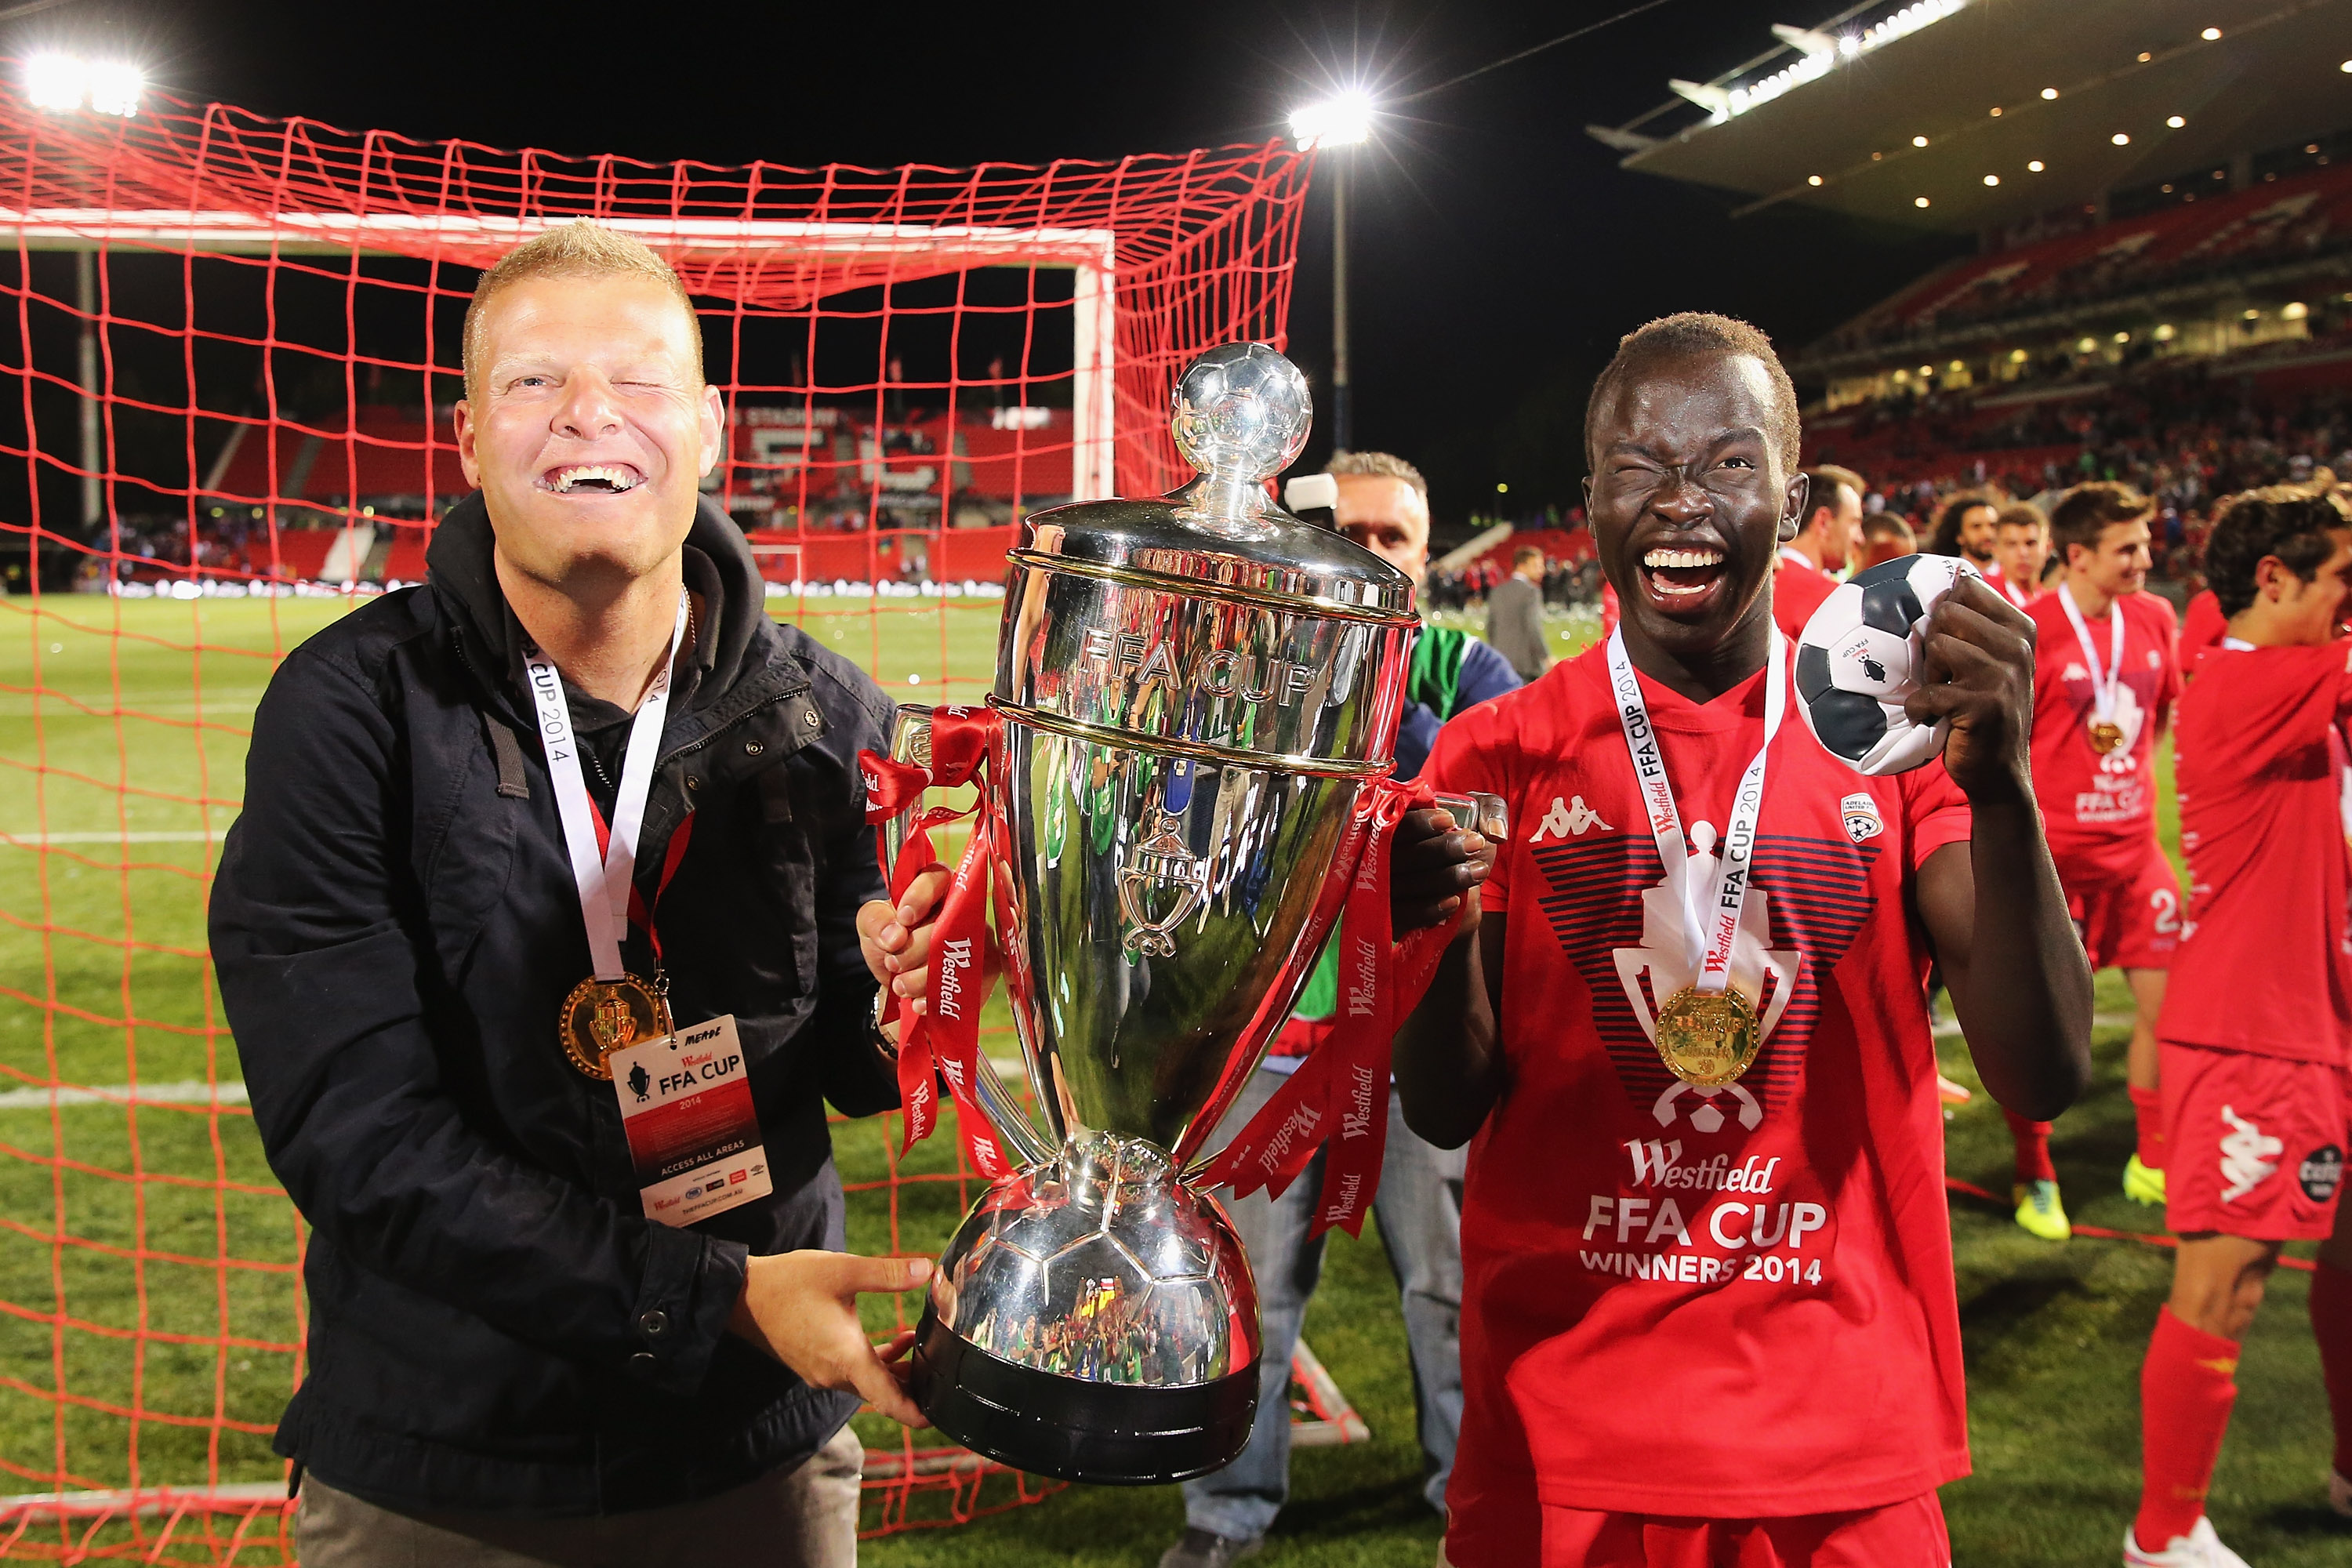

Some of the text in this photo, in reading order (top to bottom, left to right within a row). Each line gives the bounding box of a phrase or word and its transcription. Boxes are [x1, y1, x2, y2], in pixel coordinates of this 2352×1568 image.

[1079, 627, 1320, 706] FFA CUP
[1842, 647, 1856, 658] CUP
[1855, 638, 1868, 648] FFA
[530, 662, 571, 763] CUP 2014
[647, 670, 667, 704] 014
[1615, 660, 1677, 837] Westfield FFA CUP 2014
[1356, 812, 1390, 893] Westfield
[1704, 766, 1762, 974] Westfield FFA CUP 2014
[940, 937, 973, 1021] Westfield
[1348, 938, 1377, 1018] Westfield
[659, 1054, 739, 1095] FFA CUP
[679, 1097, 702, 1110] 2014
[1342, 1063, 1374, 1142] Westfield
[909, 1079, 930, 1144] Westfield
[1258, 1100, 1323, 1176] Westfield
[661, 1158, 695, 1176] ACCESS
[696, 1153, 713, 1164] ALL
[716, 1139, 746, 1156] AREAS
[1623, 1138, 1782, 1195] Westfield
[1325, 1174, 1362, 1224] Westfield
[1582, 1194, 1828, 1250] FFA CUP
[1579, 1250, 1823, 1287] WINNERS 2014
